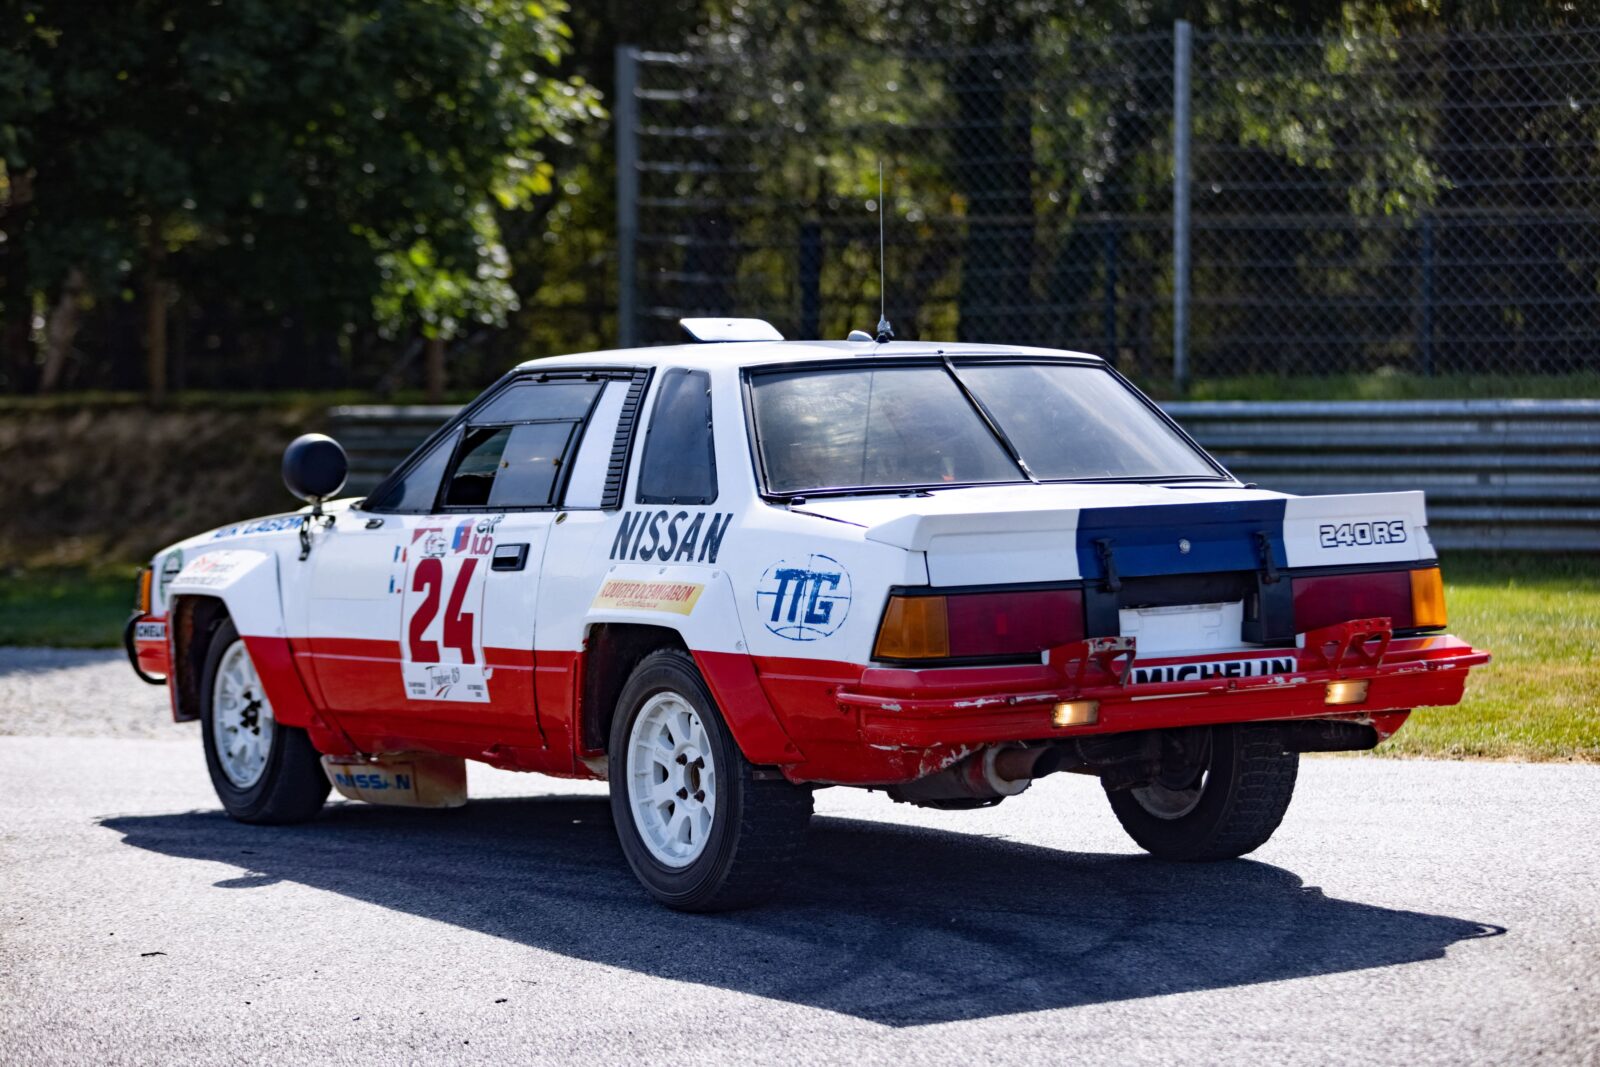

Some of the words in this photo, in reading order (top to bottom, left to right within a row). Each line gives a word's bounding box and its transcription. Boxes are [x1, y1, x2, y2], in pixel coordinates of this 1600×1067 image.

[476, 514, 505, 533] elf
[471, 534, 493, 554] lub
[609, 510, 734, 563] NISSAN
[661, 584, 696, 602] GABON
[409, 558, 478, 664] 24
[136, 625, 165, 637] ICHELI
